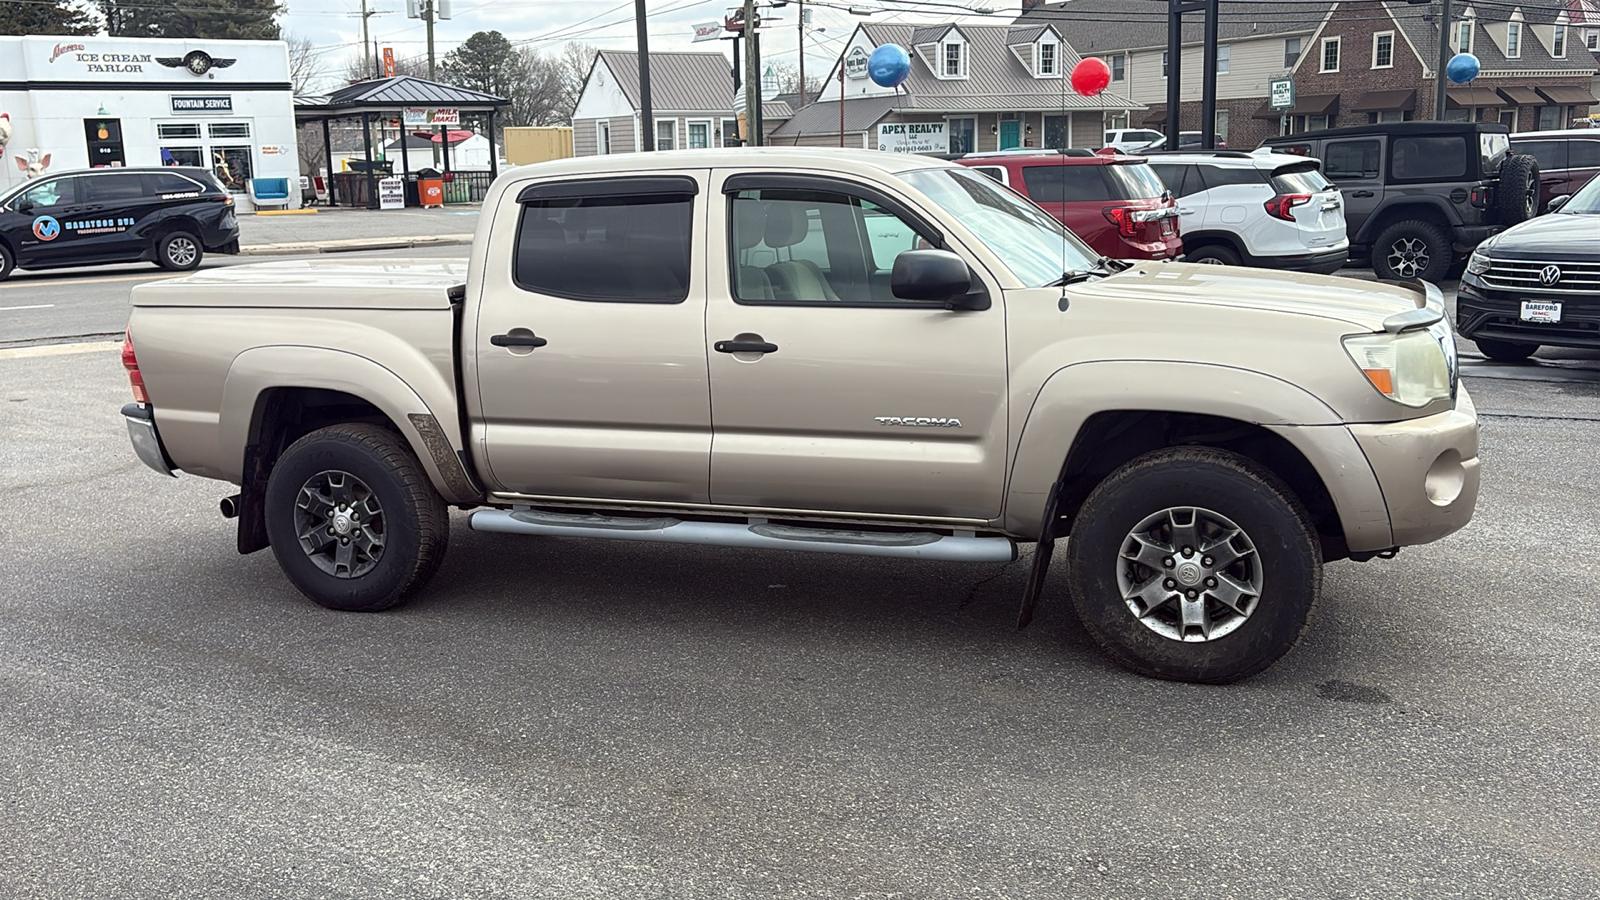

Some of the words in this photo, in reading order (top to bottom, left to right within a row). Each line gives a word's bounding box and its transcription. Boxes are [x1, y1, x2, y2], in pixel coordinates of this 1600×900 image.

[76, 54, 99, 62] ICE
[102, 54, 152, 62] CREAM
[87, 64, 143, 72] PARLOR
[173, 99, 204, 109] FOUNTAIN
[205, 99, 230, 108] SERVICE
[882, 124, 906, 134] APEX
[908, 124, 943, 134] REALTY
[65, 219, 114, 230] MARATHON
[874, 416, 963, 428] TACOMA
